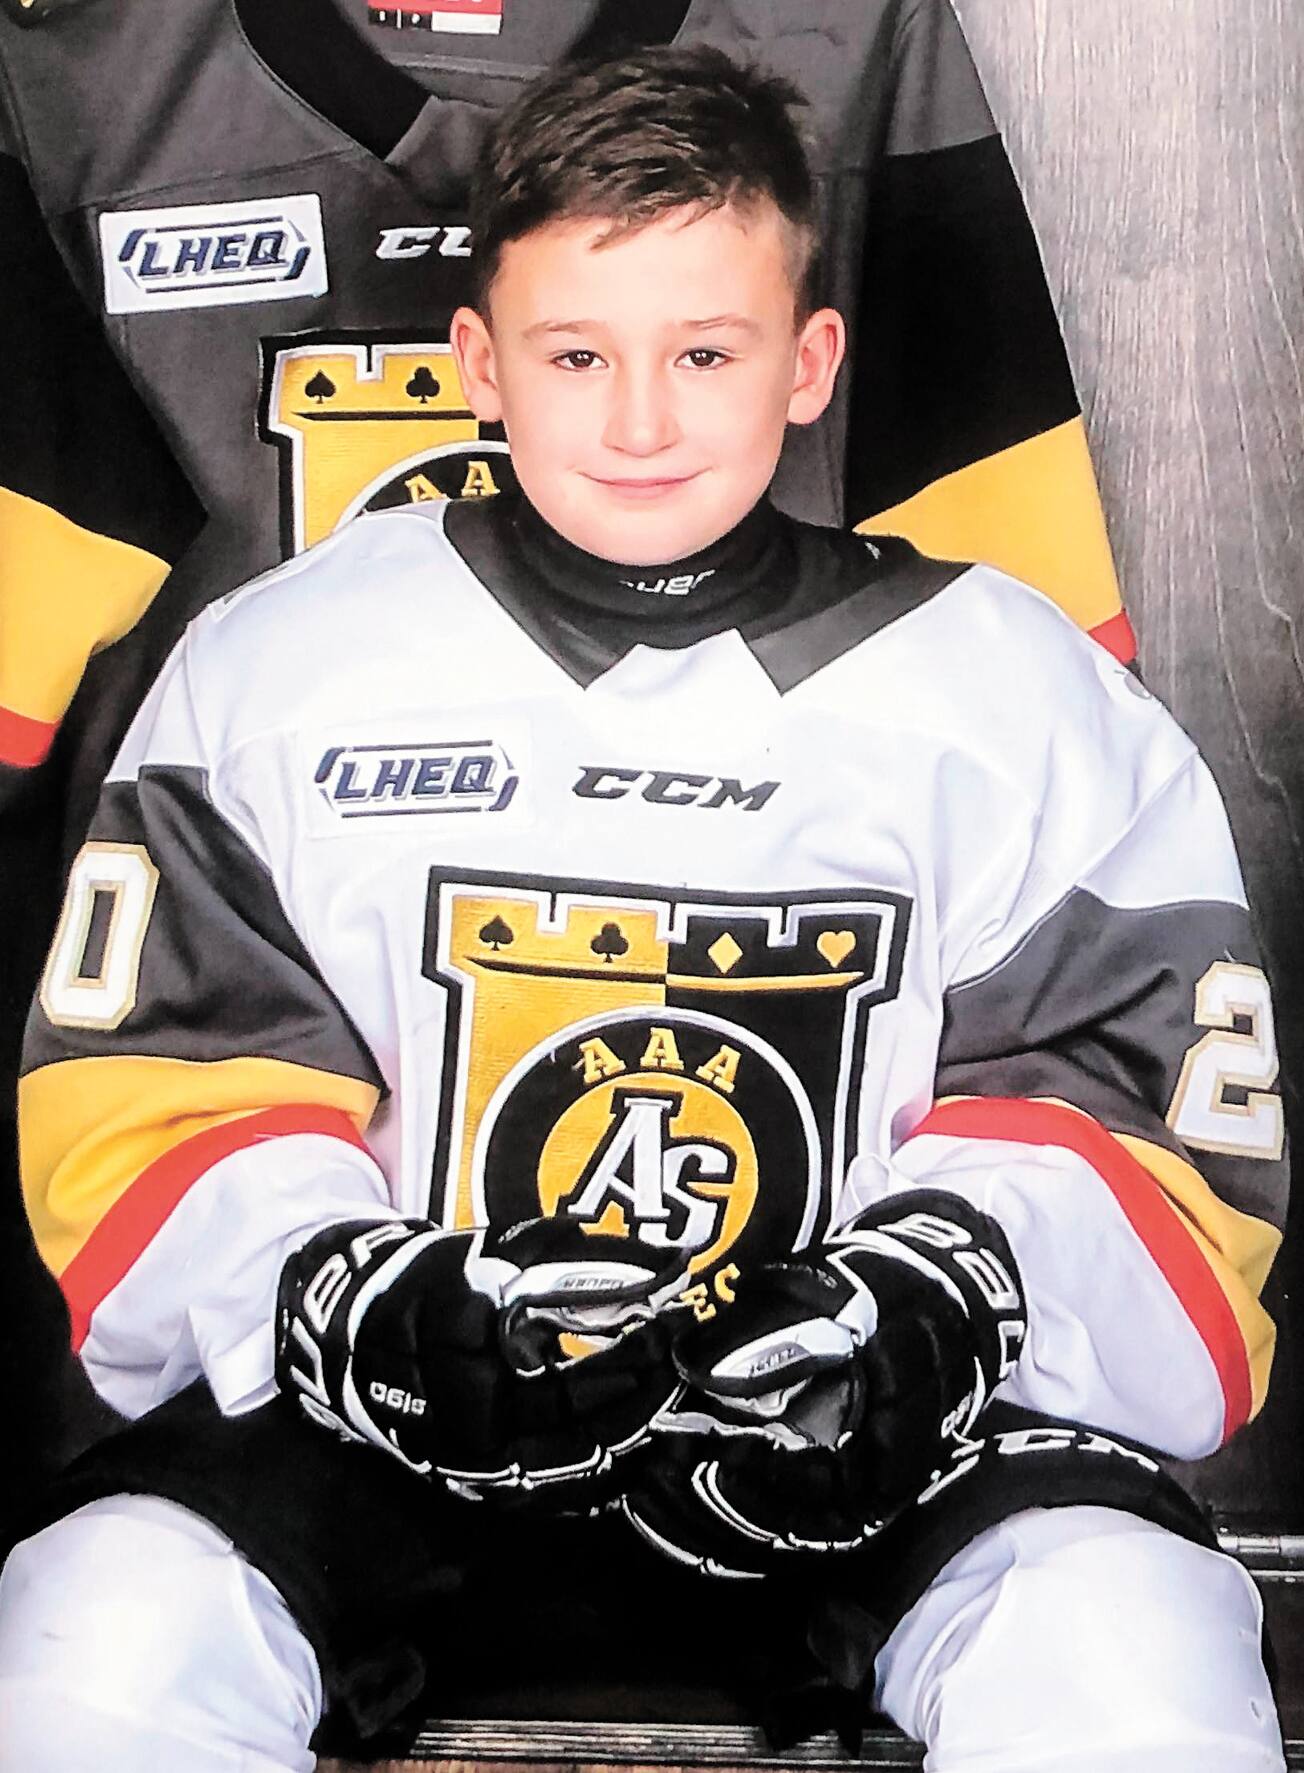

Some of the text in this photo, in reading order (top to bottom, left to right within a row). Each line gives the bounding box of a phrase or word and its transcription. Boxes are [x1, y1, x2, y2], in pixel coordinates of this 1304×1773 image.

[138, 230, 290, 279] LHEQ
[376, 226, 472, 259] CC
[333, 755, 497, 801] LHEQ
[571, 765, 782, 811] CCM
